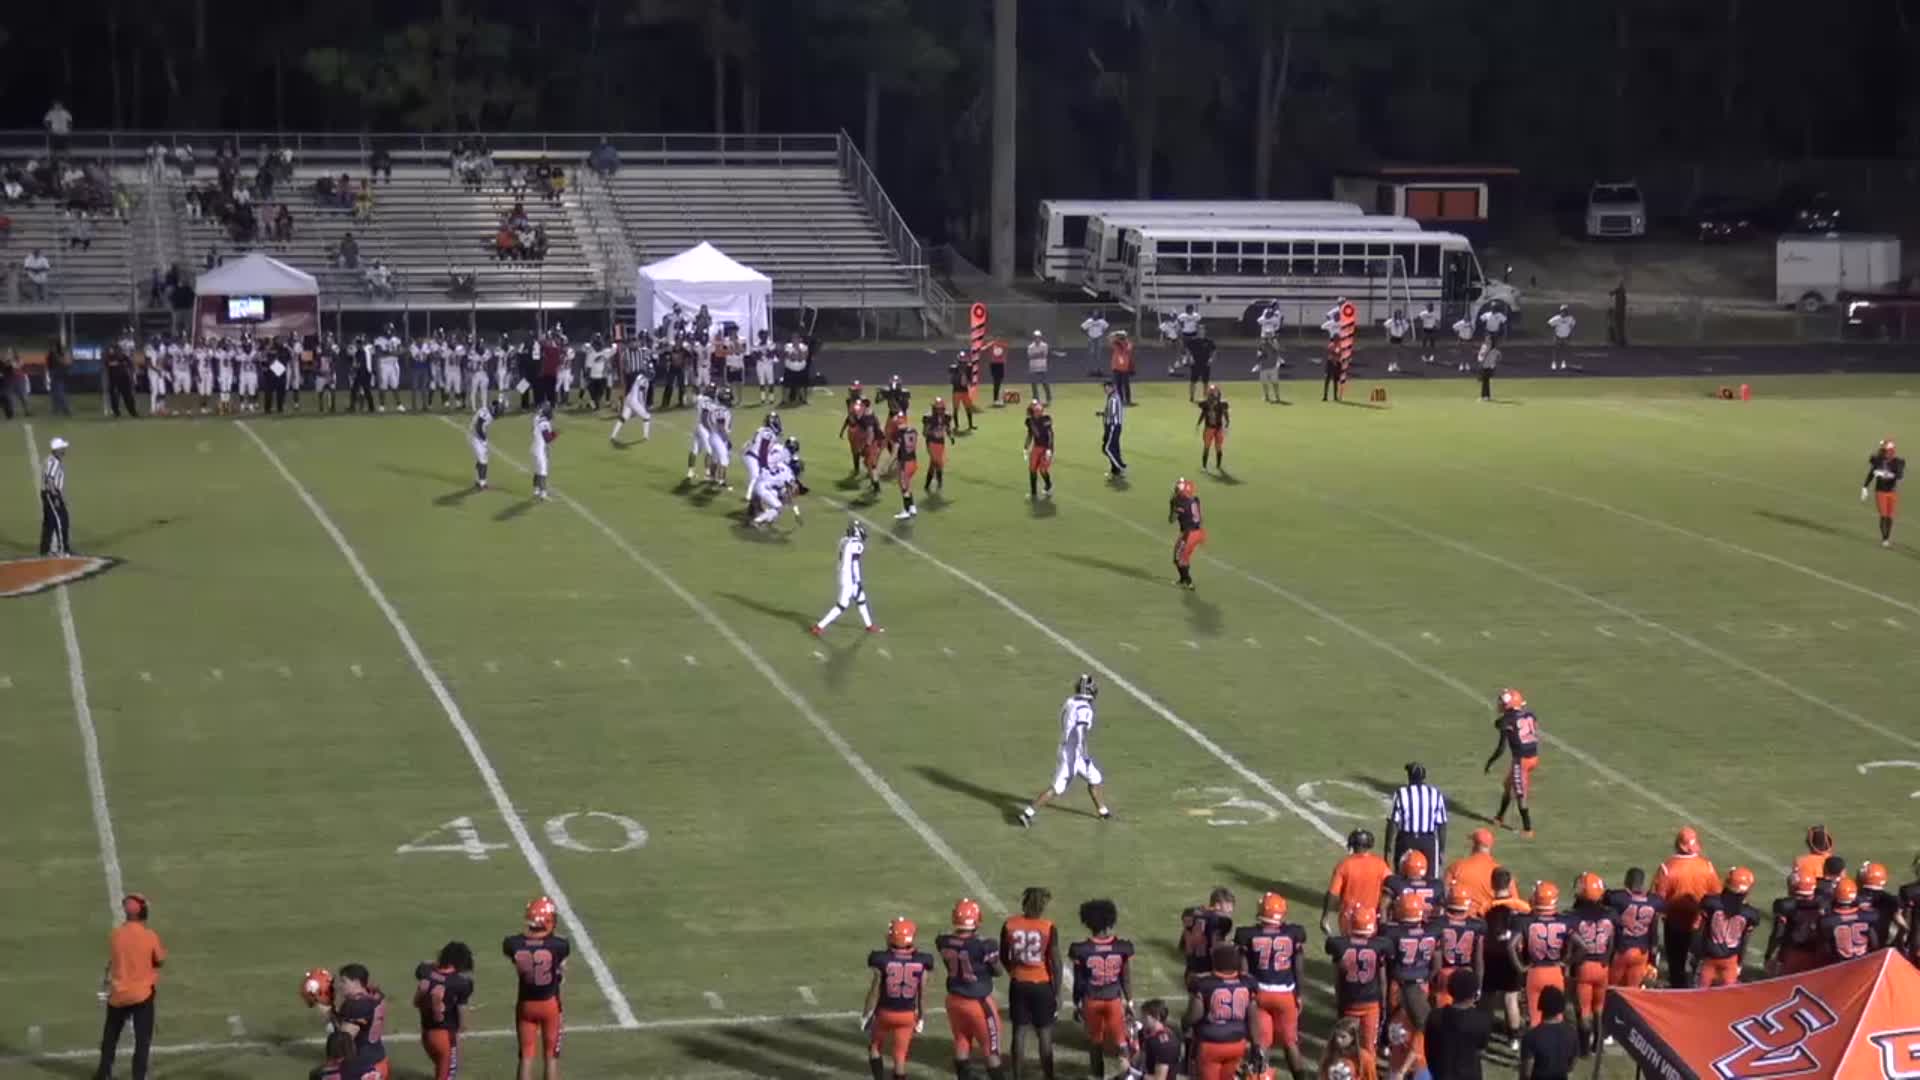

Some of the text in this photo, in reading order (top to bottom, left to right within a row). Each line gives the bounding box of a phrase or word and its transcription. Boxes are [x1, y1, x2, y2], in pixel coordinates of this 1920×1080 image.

[398, 811, 649, 860] 40
[1252, 937, 1294, 971] 72
[885, 961, 923, 999] 25
[1627, 1027, 1663, 1069] SOUTH
